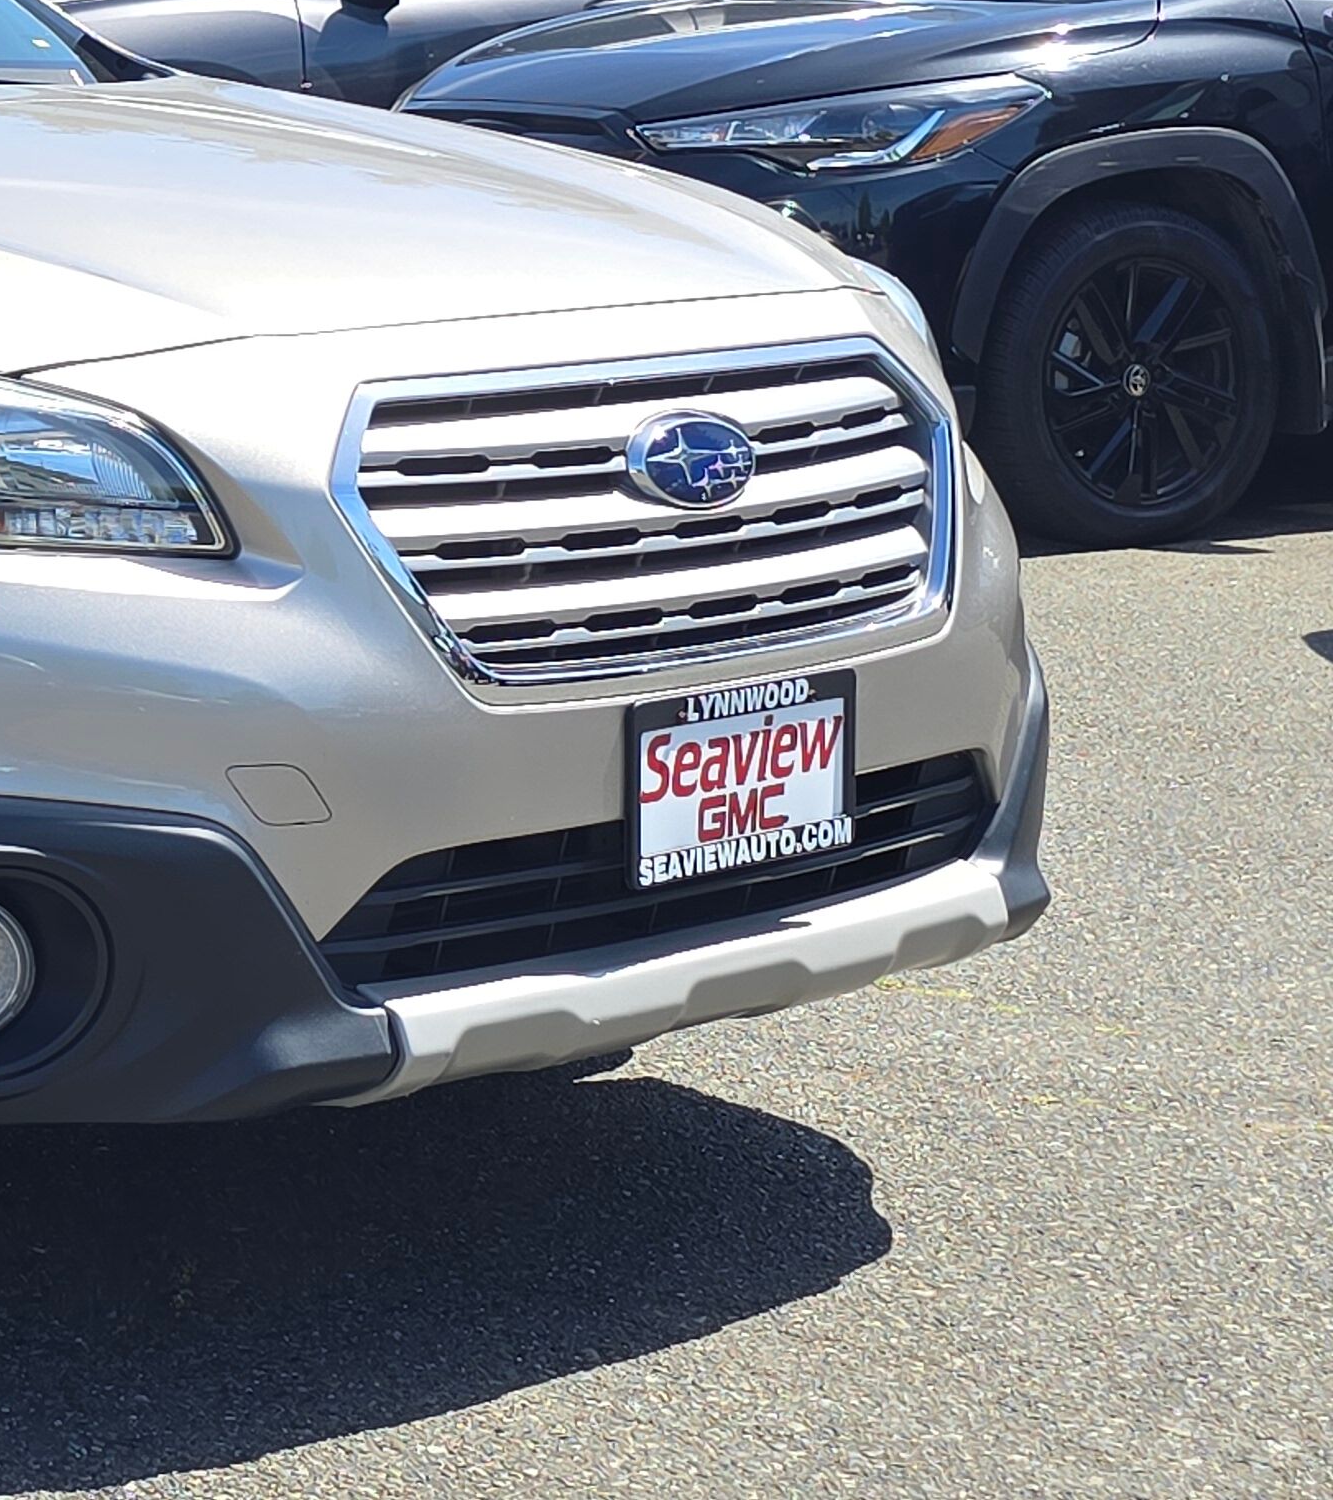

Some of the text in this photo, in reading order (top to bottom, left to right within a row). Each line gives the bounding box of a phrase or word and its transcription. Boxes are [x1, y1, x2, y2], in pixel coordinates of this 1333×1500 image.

[686, 677, 810, 722] LYNNWOOD
[638, 714, 844, 804] Seaview
[697, 783, 790, 843] GMC
[638, 815, 853, 887] SEAVIEWAUTO.COM
